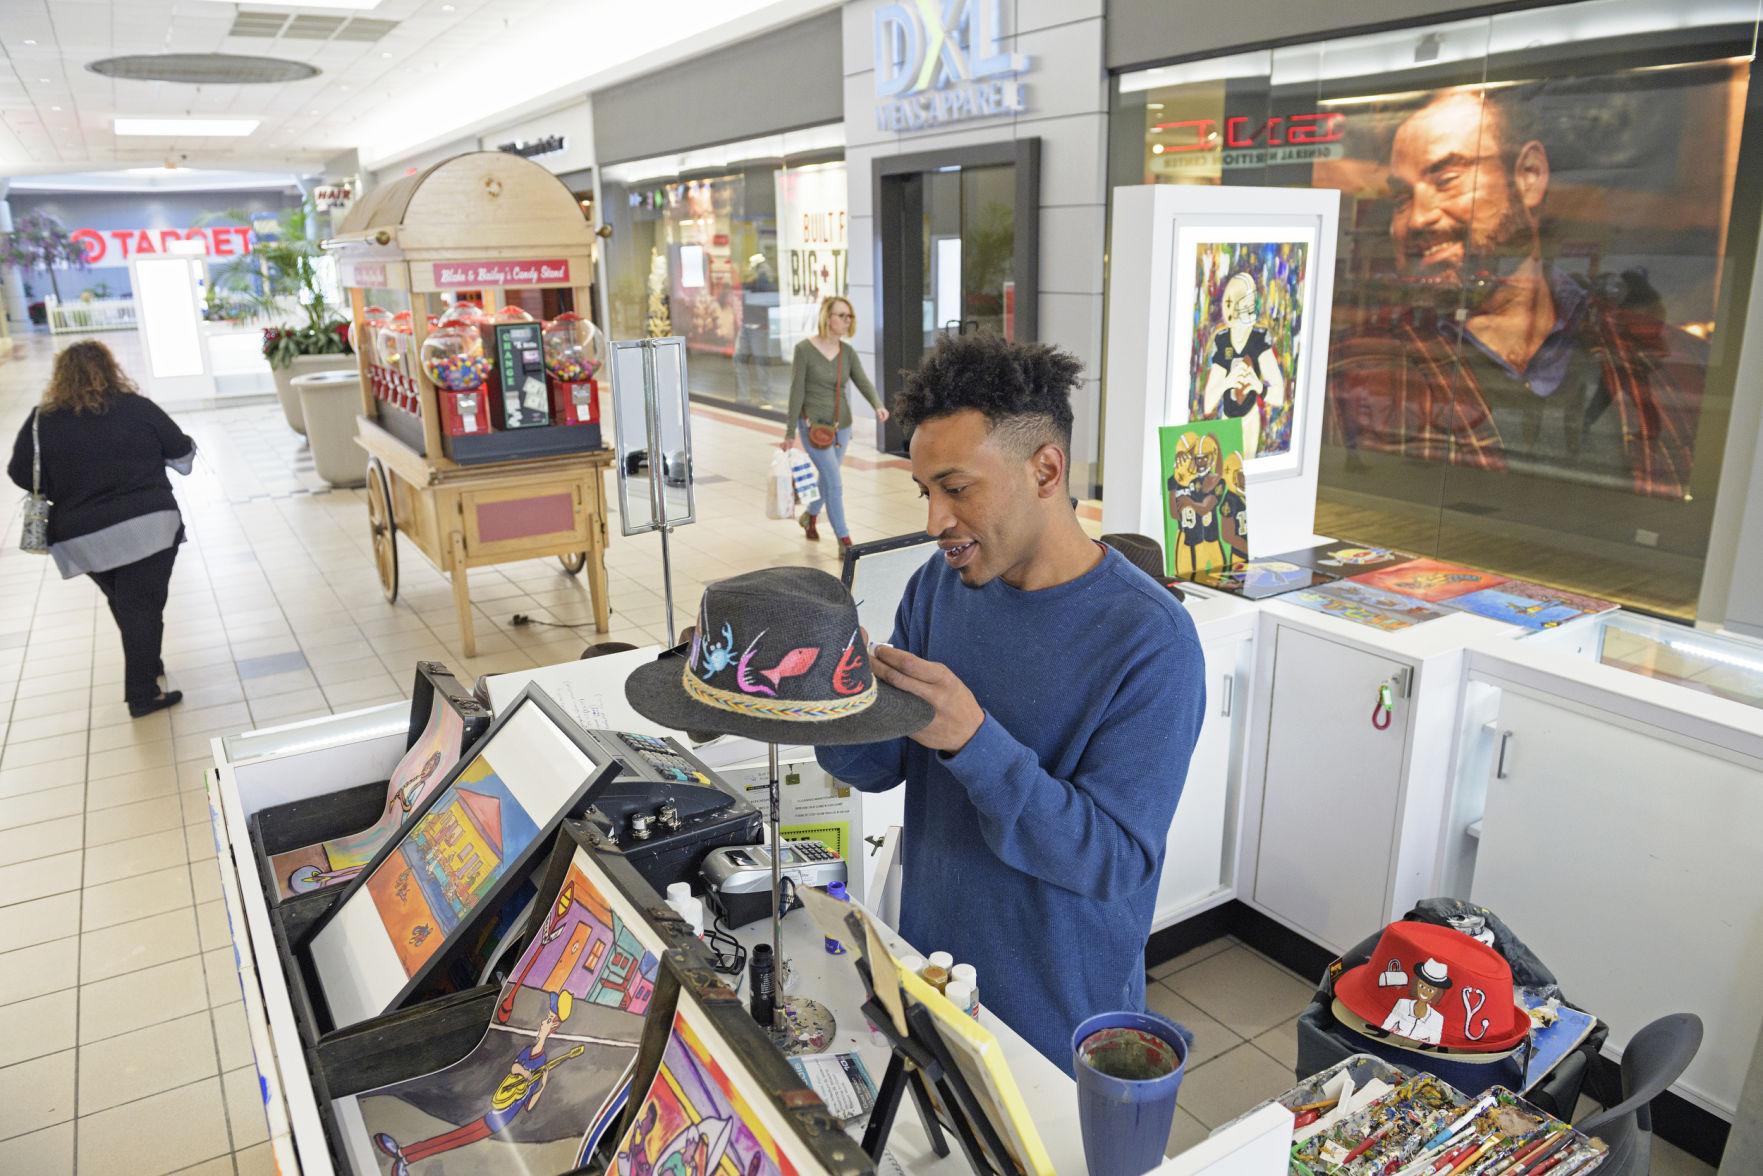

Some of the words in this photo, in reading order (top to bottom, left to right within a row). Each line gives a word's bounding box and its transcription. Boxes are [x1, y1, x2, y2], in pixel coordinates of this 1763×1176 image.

[874, 0, 1031, 98] DXL
[318, 190, 351, 201] HAIR
[803, 213, 833, 243] BUILT
[512, 265, 538, 284] Candy
[540, 264, 566, 279] Stand
